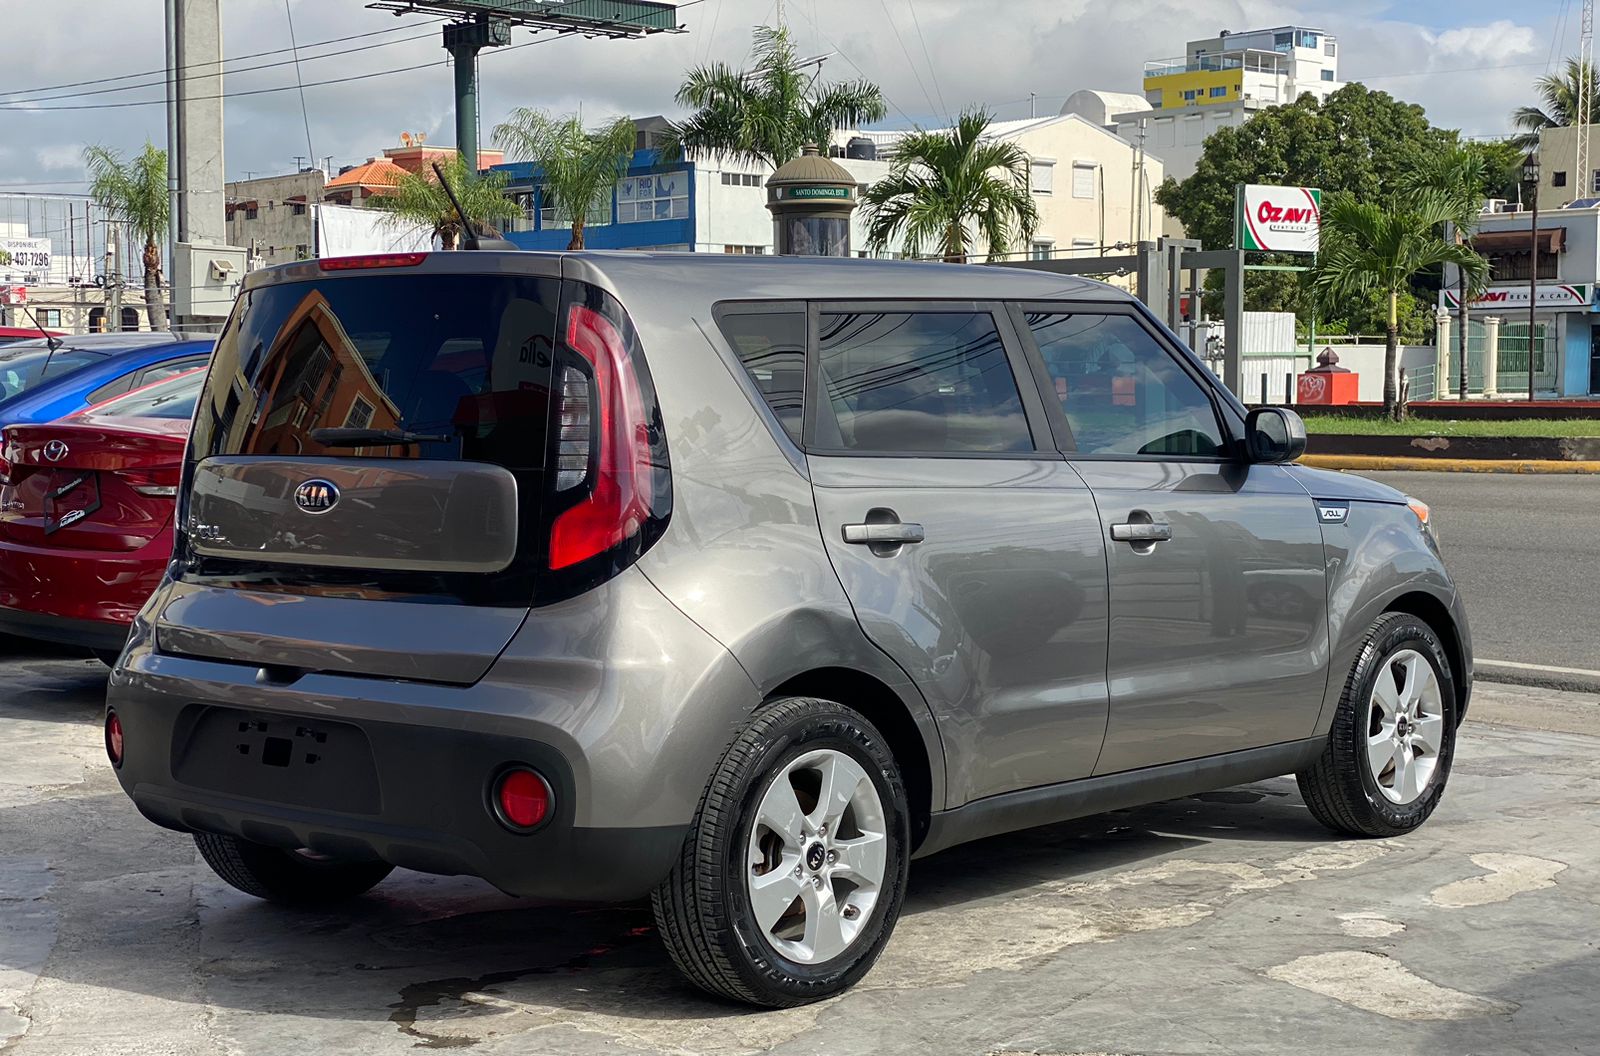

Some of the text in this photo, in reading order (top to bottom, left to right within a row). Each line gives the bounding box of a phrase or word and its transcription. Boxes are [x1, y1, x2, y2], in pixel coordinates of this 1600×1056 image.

[796, 188, 811, 196] SANTO
[8, 240, 38, 249] DISPONIBLE
[299, 486, 331, 507] KIA
[810, 846, 824, 868] KIA
